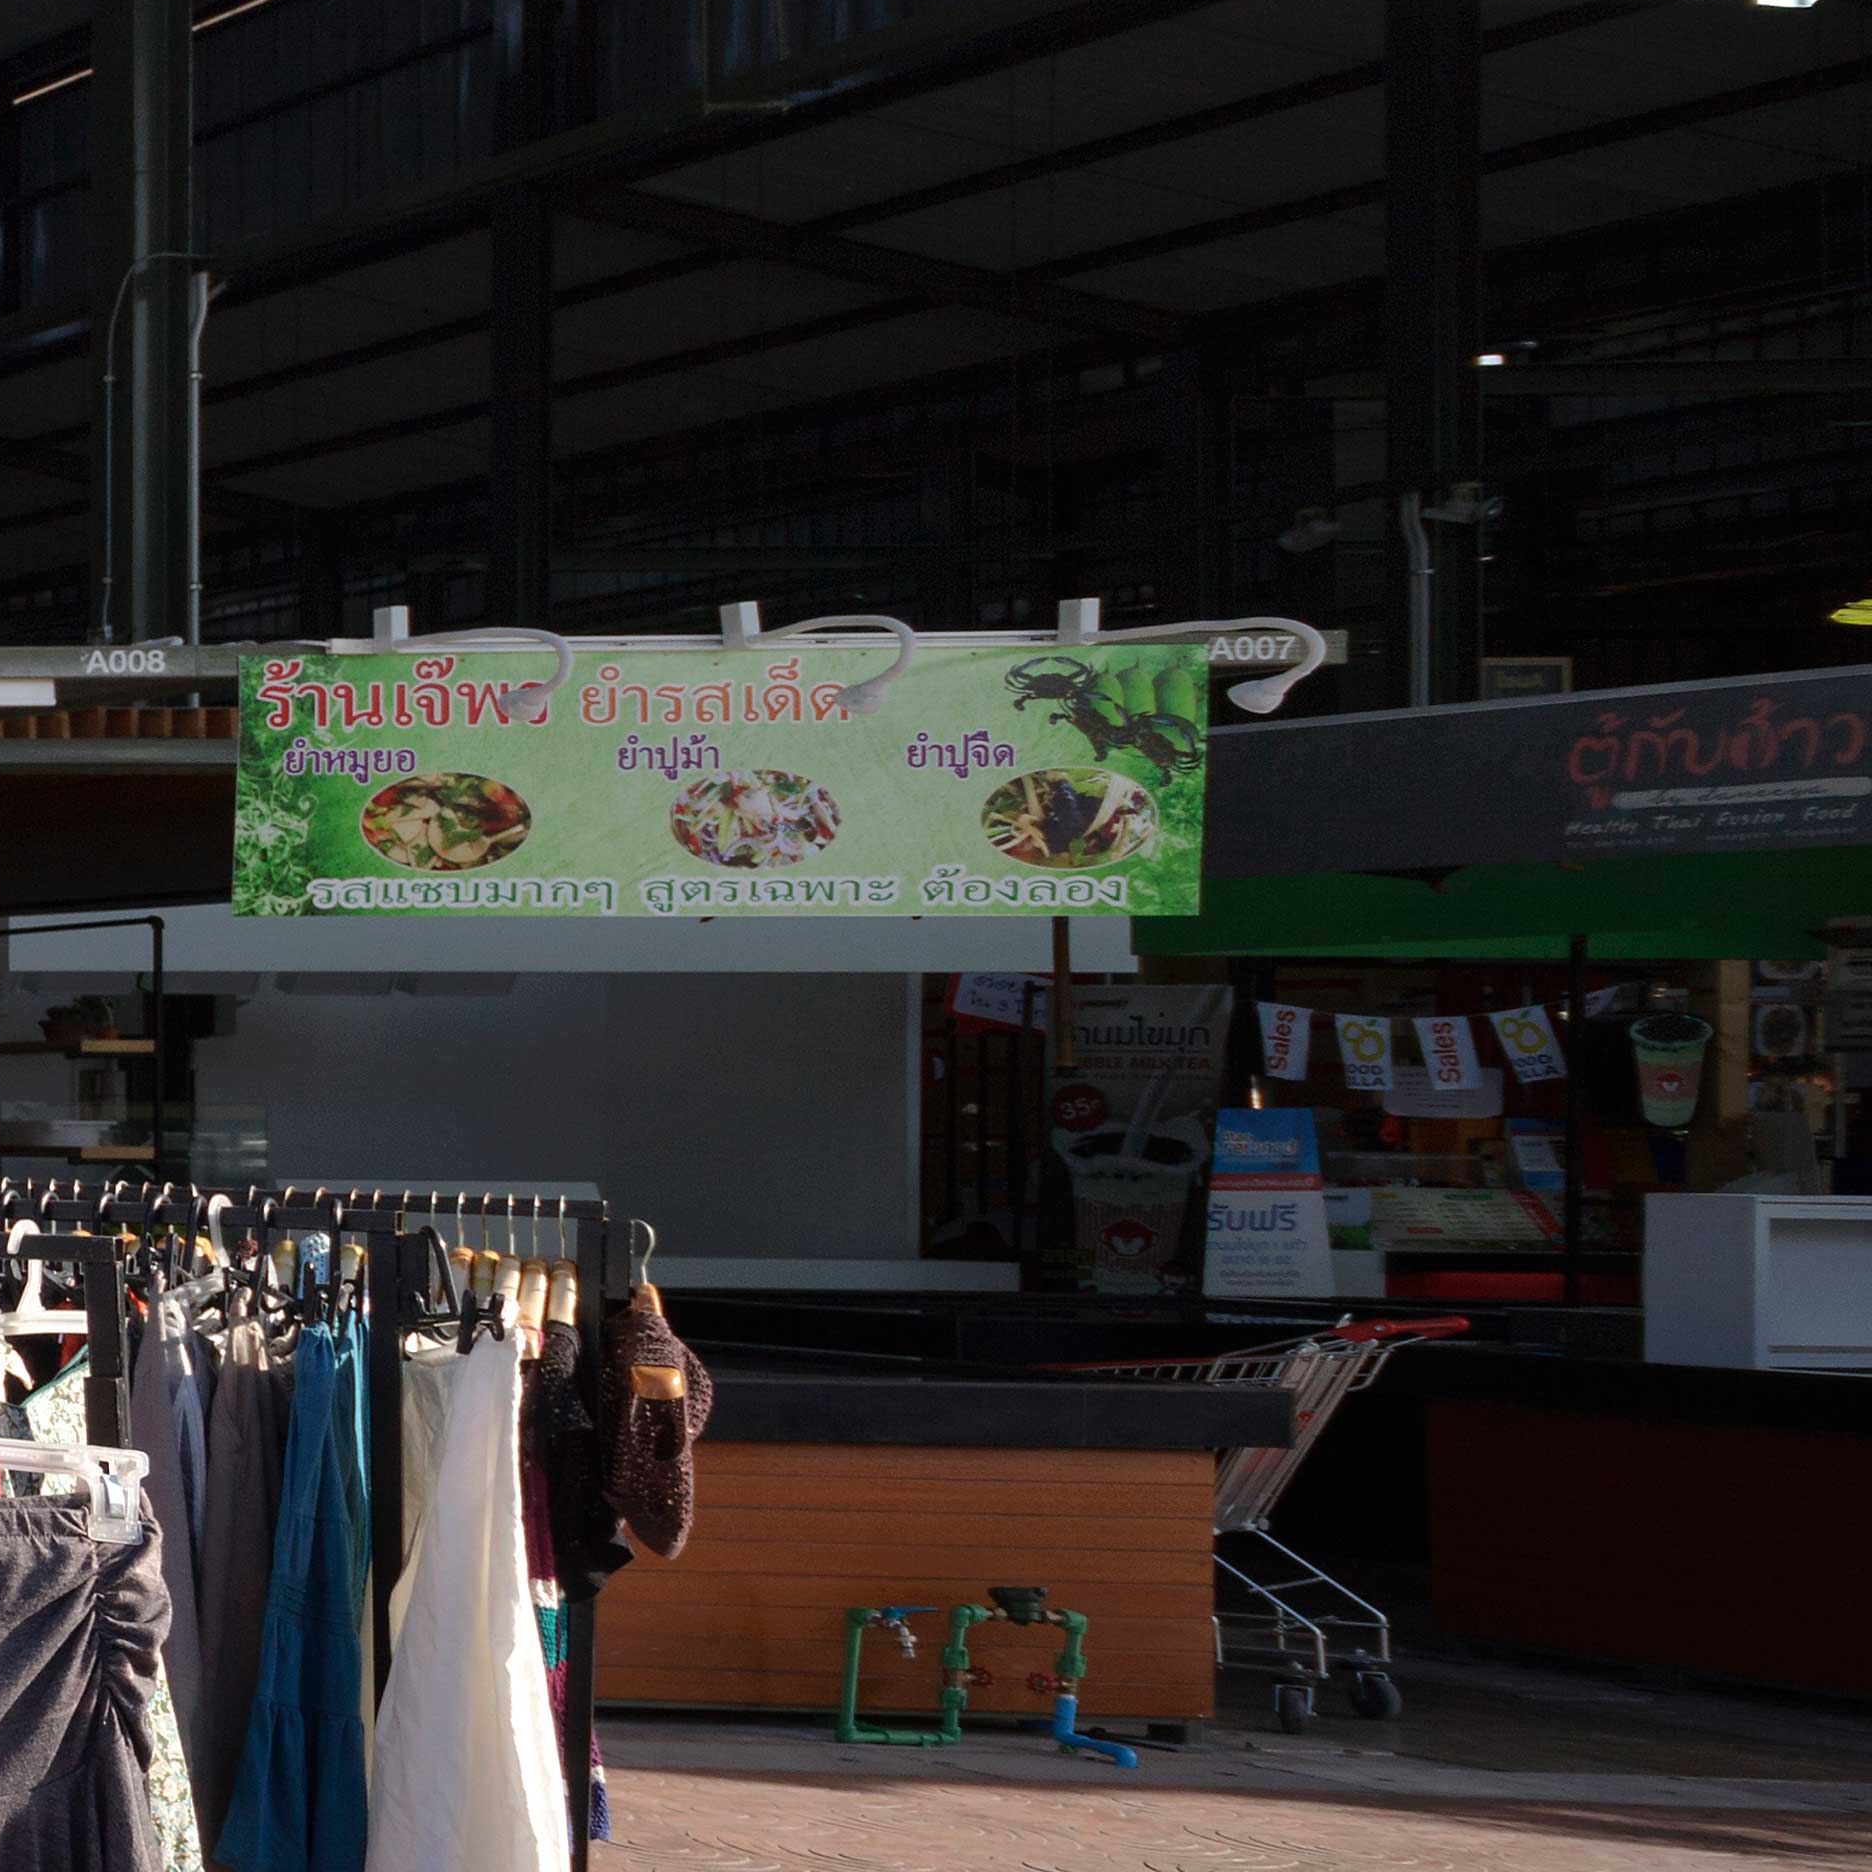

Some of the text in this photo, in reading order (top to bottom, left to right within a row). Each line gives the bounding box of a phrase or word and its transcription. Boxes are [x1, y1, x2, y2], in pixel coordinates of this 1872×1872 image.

[85, 649, 166, 674] A008
[1209, 635, 1297, 662] A007
[284, 739, 416, 784] ยำหมูยอ
[618, 734, 720, 781] ยำปูม้า
[907, 730, 1015, 779] ยำปูจืด
[1564, 802, 1859, 836] Healthy Thai Fusion Food
[310, 867, 1126, 912] รสแซบมากๆ สูตรเฉพาะ ต้องลอง
[1072, 1011, 1211, 1054] านมไข่มุก
[1267, 1008, 1297, 1071] Sales
[1433, 1020, 1462, 1084] Sales
[1207, 1203, 1298, 1232] รับฟรี
